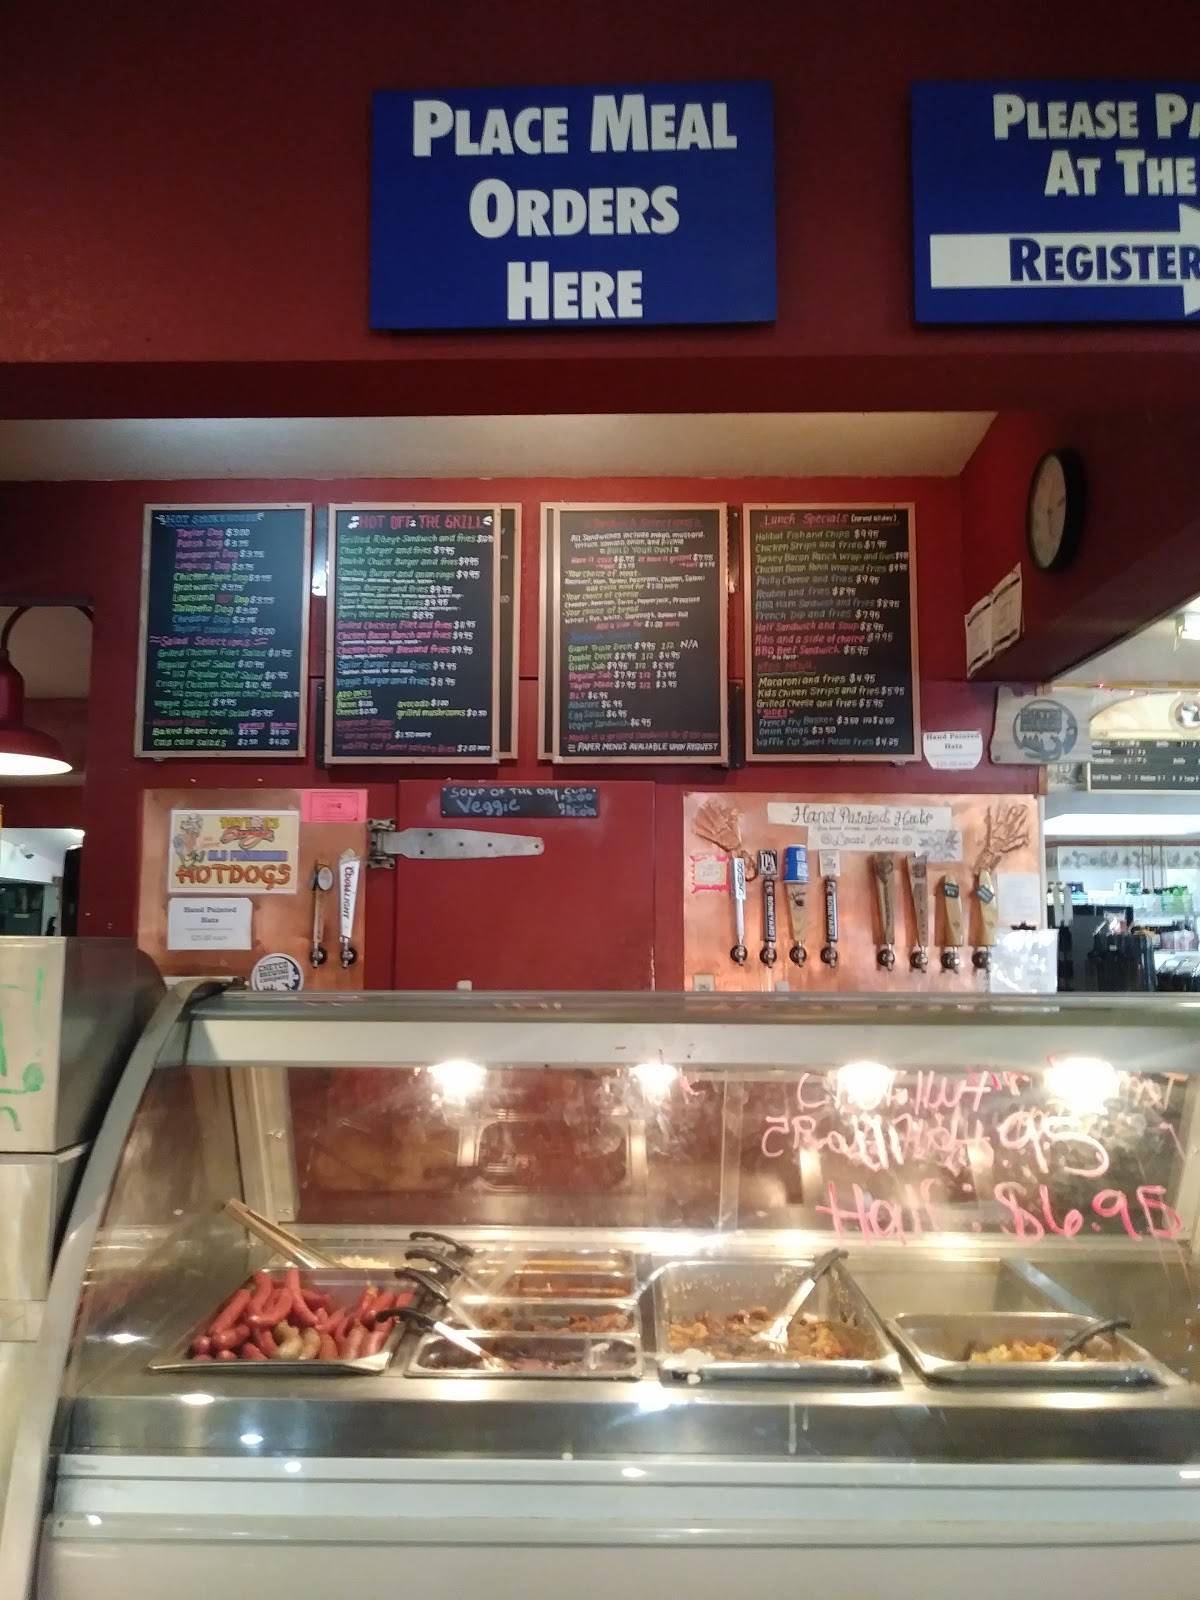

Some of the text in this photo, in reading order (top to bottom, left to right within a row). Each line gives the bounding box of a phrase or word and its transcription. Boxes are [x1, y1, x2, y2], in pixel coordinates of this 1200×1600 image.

[412, 94, 737, 157] PLACE MEAL
[992, 93, 1139, 141] PLEASE
[1044, 149, 1198, 197] AT THE
[469, 178, 680, 239] ORDERS
[507, 261, 644, 321] HERE
[679, 638, 700, 651] N/A
[791, 806, 836, 825] Hand
[760, 852, 777, 868] IPA
